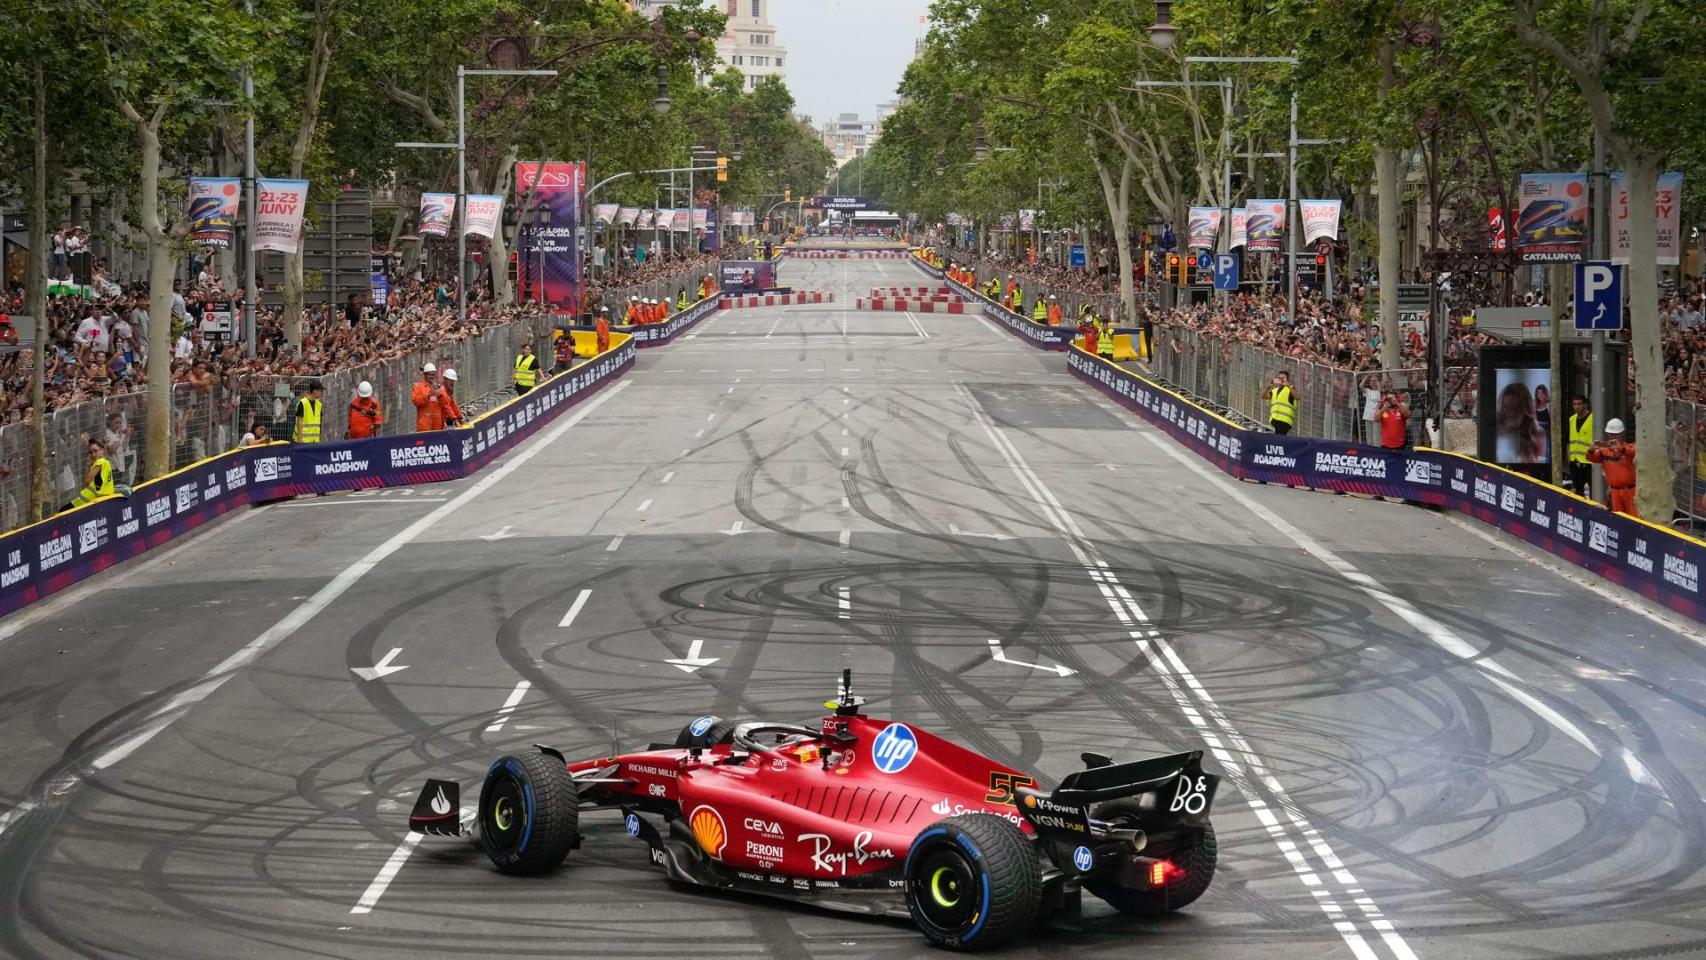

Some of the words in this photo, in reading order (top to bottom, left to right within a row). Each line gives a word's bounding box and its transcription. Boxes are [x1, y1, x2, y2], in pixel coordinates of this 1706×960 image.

[260, 192, 298, 203] 21-23
[258, 204, 296, 215] JUNY
[1220, 256, 1233, 274] P
[1584, 266, 1613, 301] P
[331, 450, 352, 462] LIVE
[391, 444, 450, 460] BARCELONA
[1266, 444, 1284, 455] LIVE
[315, 461, 368, 475] ROADSHOW
[405, 457, 434, 466] FESTIVAL
[1254, 454, 1296, 468] ROADSHOW
[1316, 452, 1386, 470] BARCELONA
[1315, 464, 1329, 472] FAN
[1330, 466, 1364, 476] FESTIVAL
[1365, 469, 1386, 478] 2024
[1537, 498, 1546, 512] LIVE
[122, 507, 132, 521] LIVE
[1557, 510, 1583, 534] BARCELONA
[117, 519, 139, 538] ROADSHOW
[40, 534, 72, 560] BARCELONA
[1636, 538, 1647, 555] LIVE
[9, 549, 21, 567] LIVE
[1627, 551, 1653, 573] ROADSHOW
[1, 563, 30, 588] ROADSHOW
[1664, 553, 1697, 581] BARCELONA
[876, 724, 914, 771] hp
[628, 763, 657, 774] RICHARD
[658, 768, 678, 778] MILLE
[1037, 798, 1080, 814] V-Power
[627, 814, 639, 836] hp
[1029, 814, 1065, 828] VGW
[746, 840, 783, 858] PERONI
[798, 831, 894, 875] Ray-Ban
[1076, 847, 1091, 870] hp
